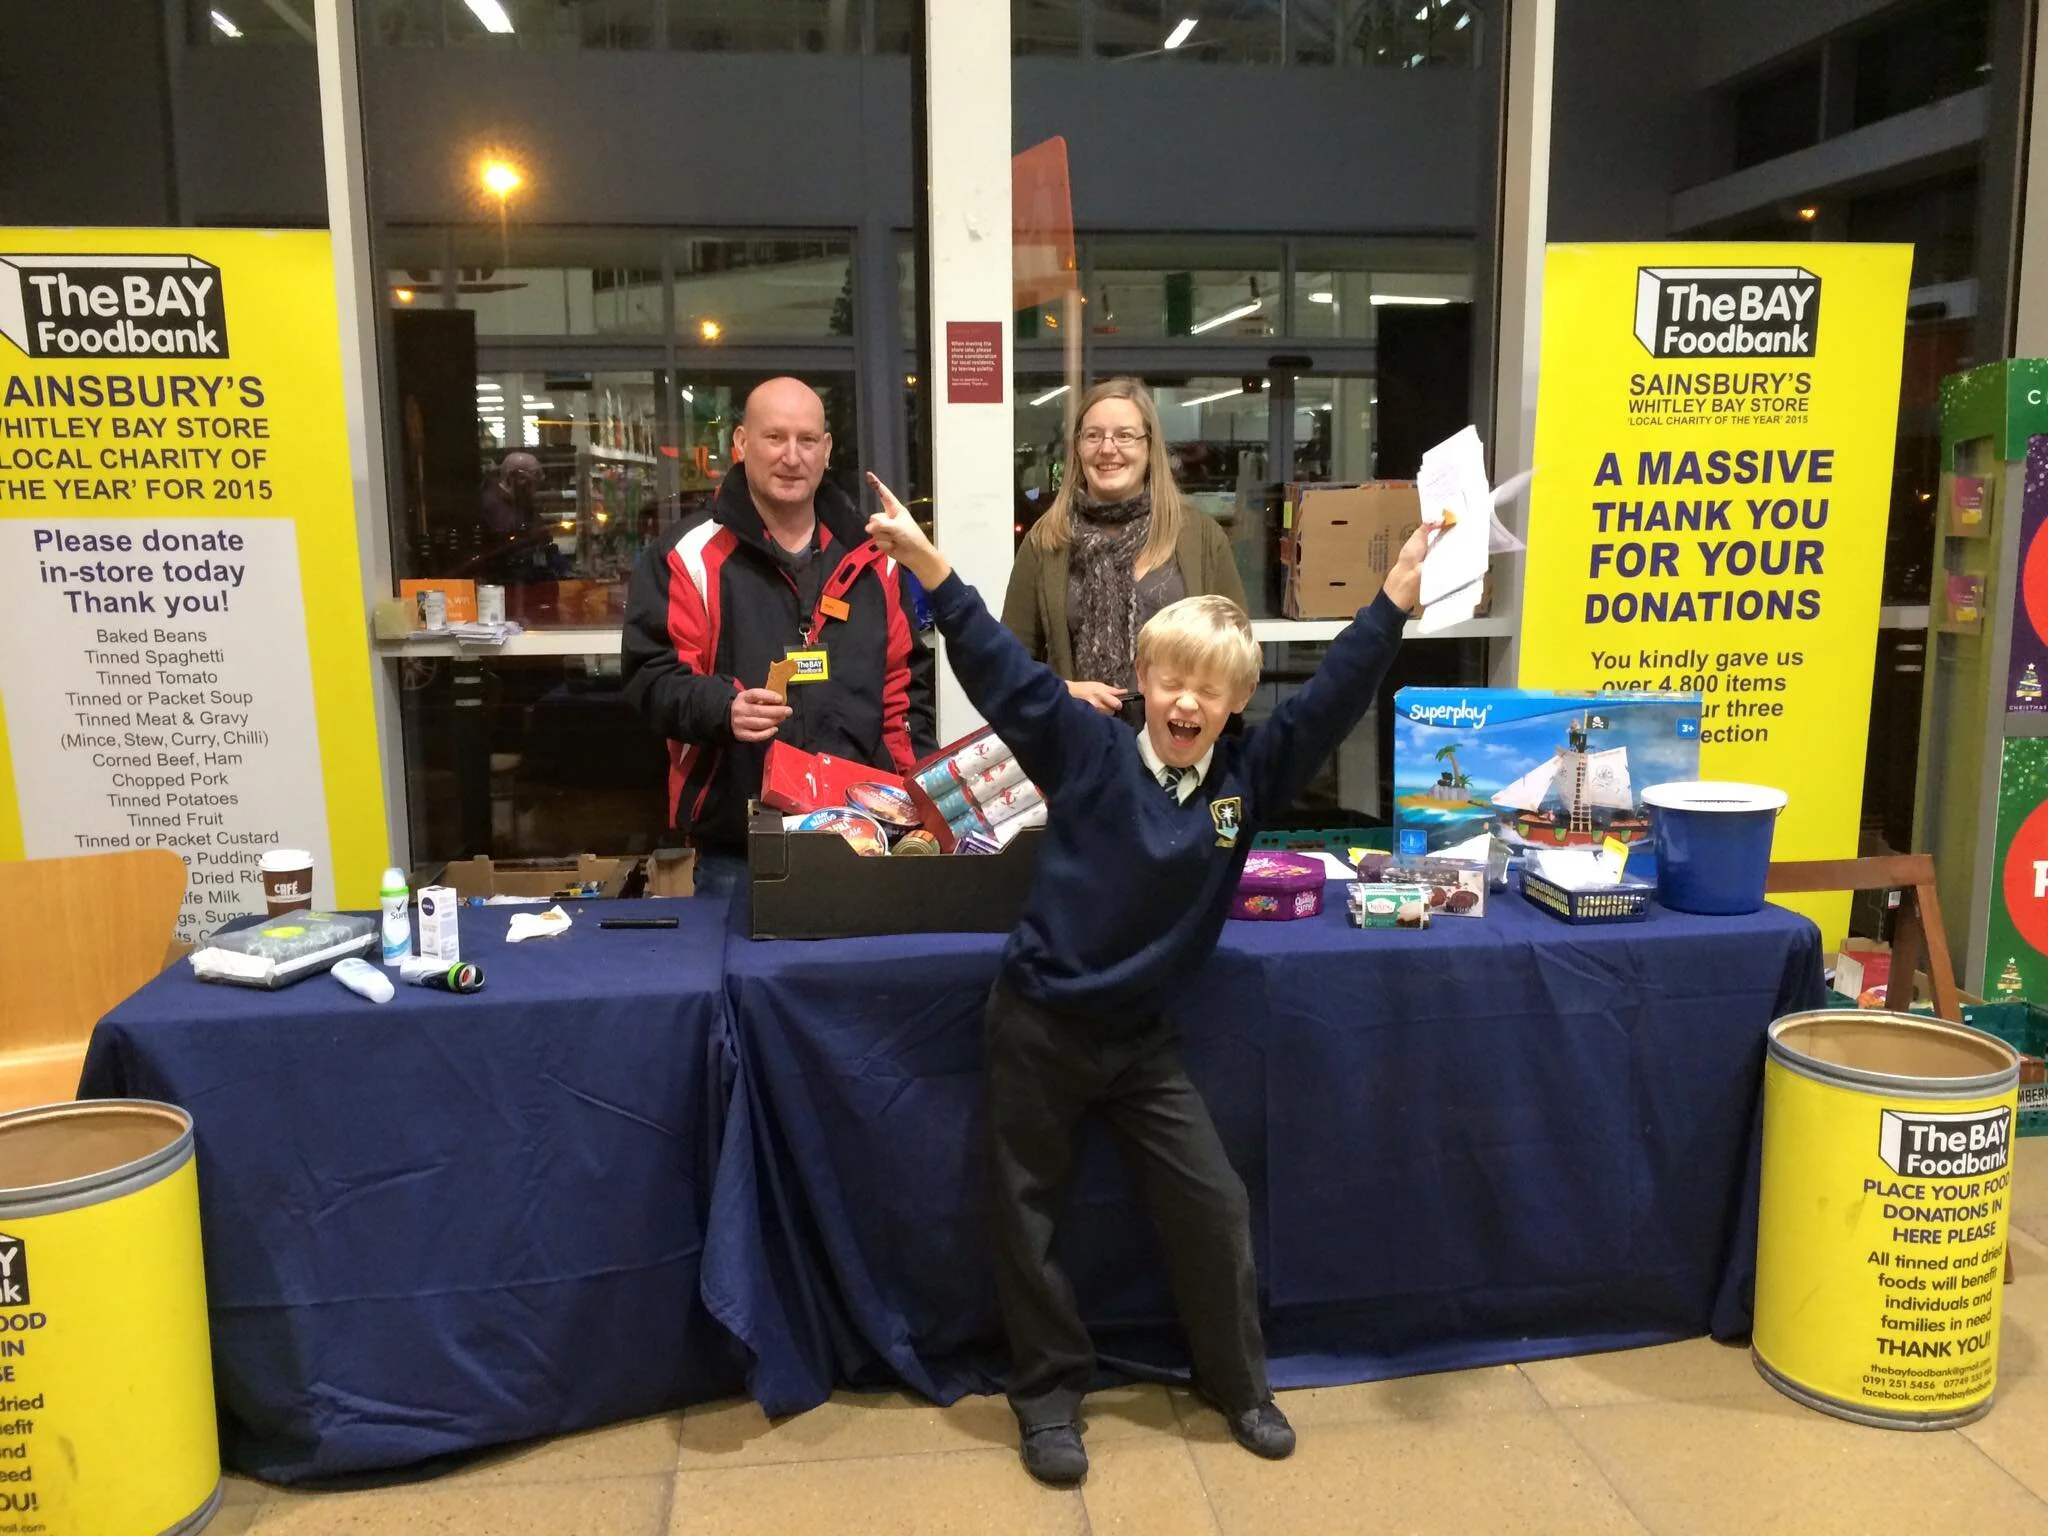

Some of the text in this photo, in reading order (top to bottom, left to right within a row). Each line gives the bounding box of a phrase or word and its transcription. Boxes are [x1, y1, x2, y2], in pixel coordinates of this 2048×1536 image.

[29, 272, 214, 318] The BAY
[1666, 282, 1815, 322] The BAY
[37, 319, 220, 354] Foodbank
[1663, 324, 1809, 354] Foodbank
[4, 375, 266, 408] AINSBURY'S
[1629, 373, 1812, 396] SAINSBURY'S
[1629, 397, 1809, 413] WHITLEY BAY STORE
[0, 417, 270, 439] HITLEY BAY STORE
[1666, 416, 1712, 426] CHARITY
[1714, 416, 1728, 425] OF
[1730, 416, 1750, 425] THE
[1785, 415, 1808, 424] 2015
[100, 448, 222, 470] CHARITY
[231, 448, 267, 470] OF
[1593, 449, 1834, 487] A MASSIVE
[53, 478, 137, 500] YEAR'
[146, 479, 205, 500] FOR
[213, 479, 273, 500] 2015
[1592, 498, 1830, 533] THANK YOU
[33, 528, 244, 553] Please donate
[1589, 540, 1825, 579] FOR YOUR
[40, 560, 245, 587] in-store today
[63, 589, 230, 618] Thank you!
[1584, 589, 1822, 624] DONATIONS
[97, 629, 207, 644] Baked Beans
[85, 649, 225, 667] Tinned Spaghetti
[1591, 650, 1804, 673] You kindly gave us
[96, 670, 218, 685] Tinned Tomato
[1726, 674, 1786, 692] items
[65, 691, 253, 708] Tinned or Packet Soup
[1727, 700, 1783, 718] three
[75, 711, 249, 728] Tinned Meat & Gravy
[60, 730, 269, 751] (Mince, Stew, Curry, Chilli)
[1701, 725, 1768, 743] ection
[92, 752, 243, 768] Corned Beef, Ham
[112, 771, 229, 790] Chopped Pork
[107, 791, 239, 808] Tinned Potatoes
[127, 812, 224, 828] Tinned Fruit
[74, 831, 279, 849] Tinned or Packet Custard
[192, 870, 264, 885] Dried Ric
[181, 890, 240, 905] ife Milk
[1908, 1115, 2010, 1152] The BAY
[1907, 1145, 2007, 1175] Foodbank
[1863, 1178, 1926, 1200] PLACE
[1931, 1183, 1980, 1201] YOUR
[1883, 1197, 2003, 1223] DONATIONS IN
[1893, 1221, 1996, 1244] HERE PLEASE
[1868, 1241, 2003, 1270] All tinned and dried
[1877, 1266, 1998, 1291] foods will benefit
[1885, 1288, 1993, 1311] individuals and
[1880, 1307, 1992, 1332] families in need
[1, 1339, 25, 1357] IN
[1876, 1330, 1991, 1358] THANK YOU!
[1862, 1375, 1886, 1386] 0191
[1888, 1379, 1907, 1389] 251
[1909, 1381, 1936, 1390] 5456
